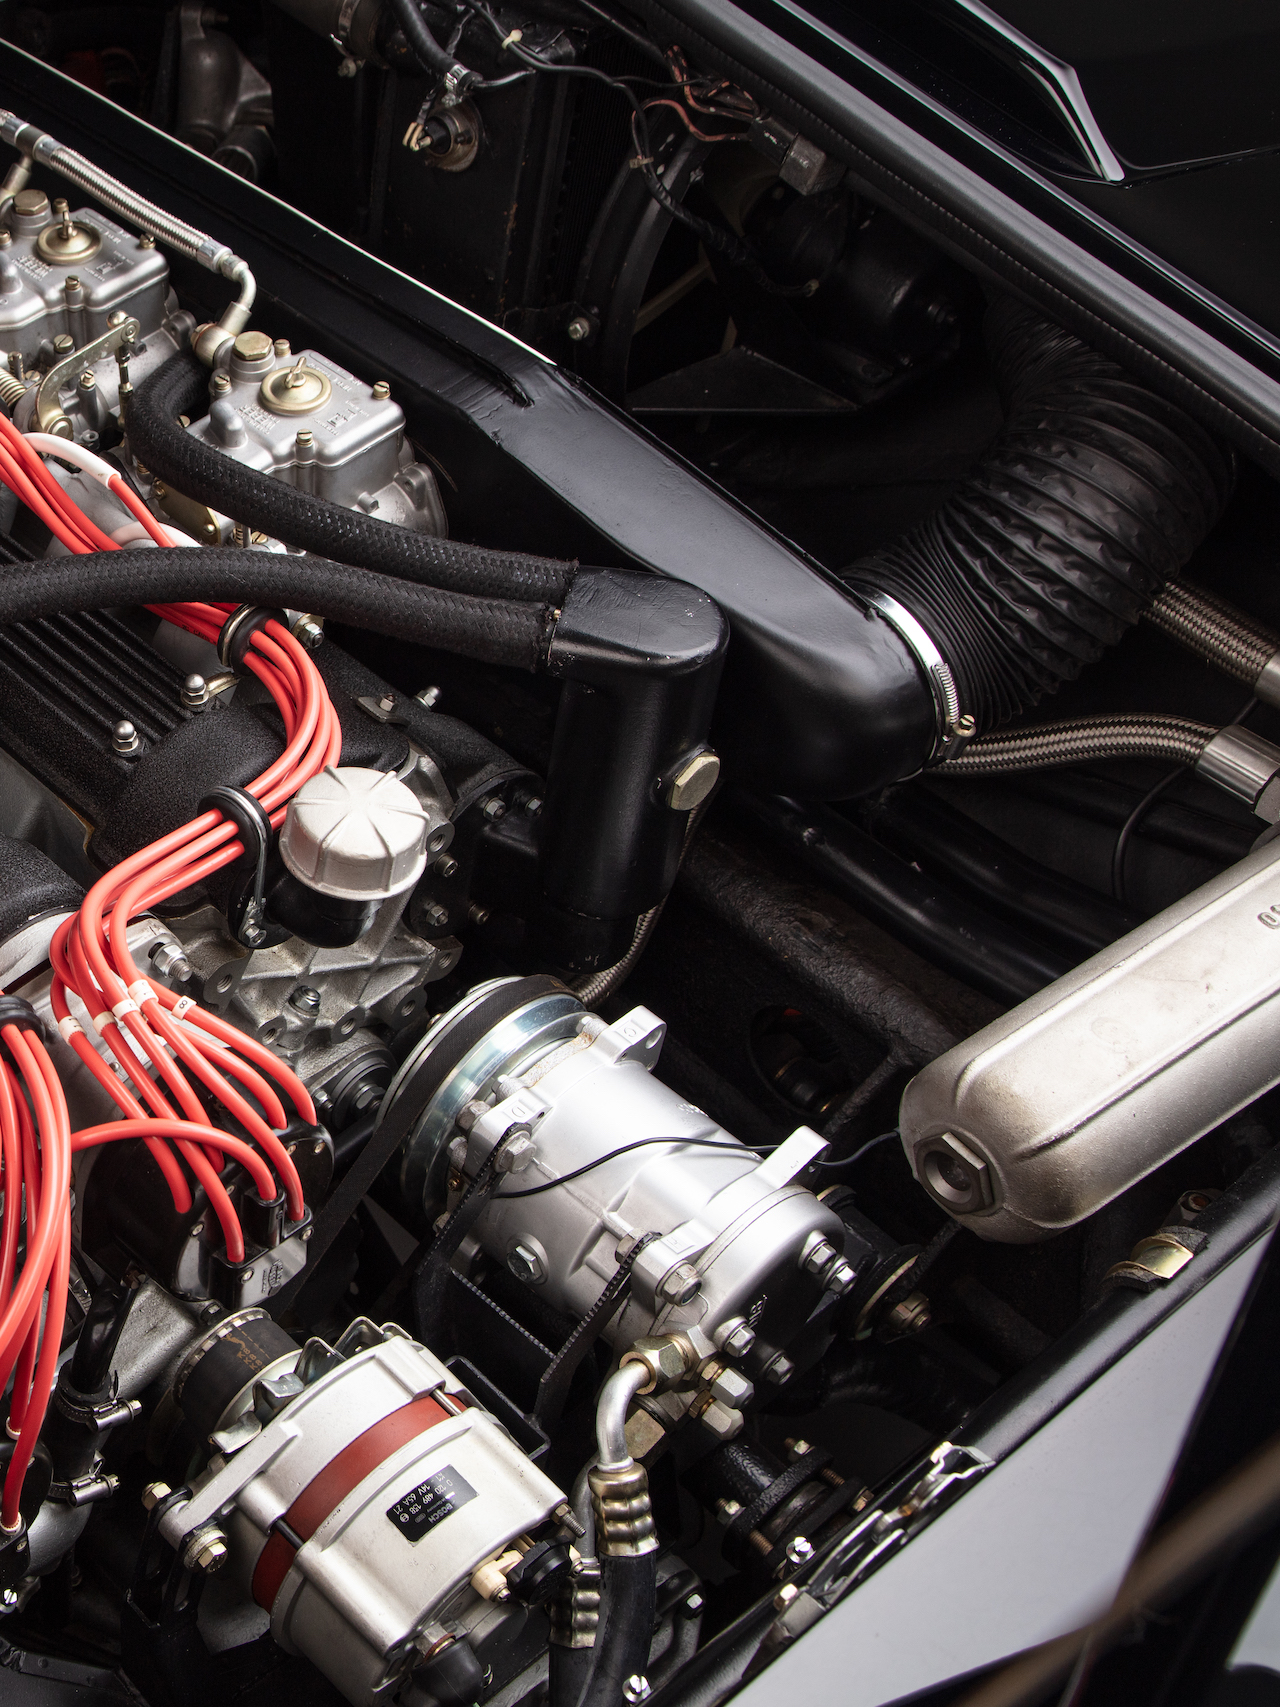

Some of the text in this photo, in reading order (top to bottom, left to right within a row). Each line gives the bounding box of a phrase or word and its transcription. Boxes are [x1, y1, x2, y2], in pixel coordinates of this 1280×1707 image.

[238, 404, 276, 430] WEBER
[179, 1000, 188, 1009] 8
[417, 1483, 431, 1496] 14V
[434, 1484, 447, 1495] 120
[402, 1493, 417, 1506] 65A
[422, 1493, 434, 1505] 489
[393, 1504, 404, 1515] 21
[428, 1502, 454, 1524] BOSCH
